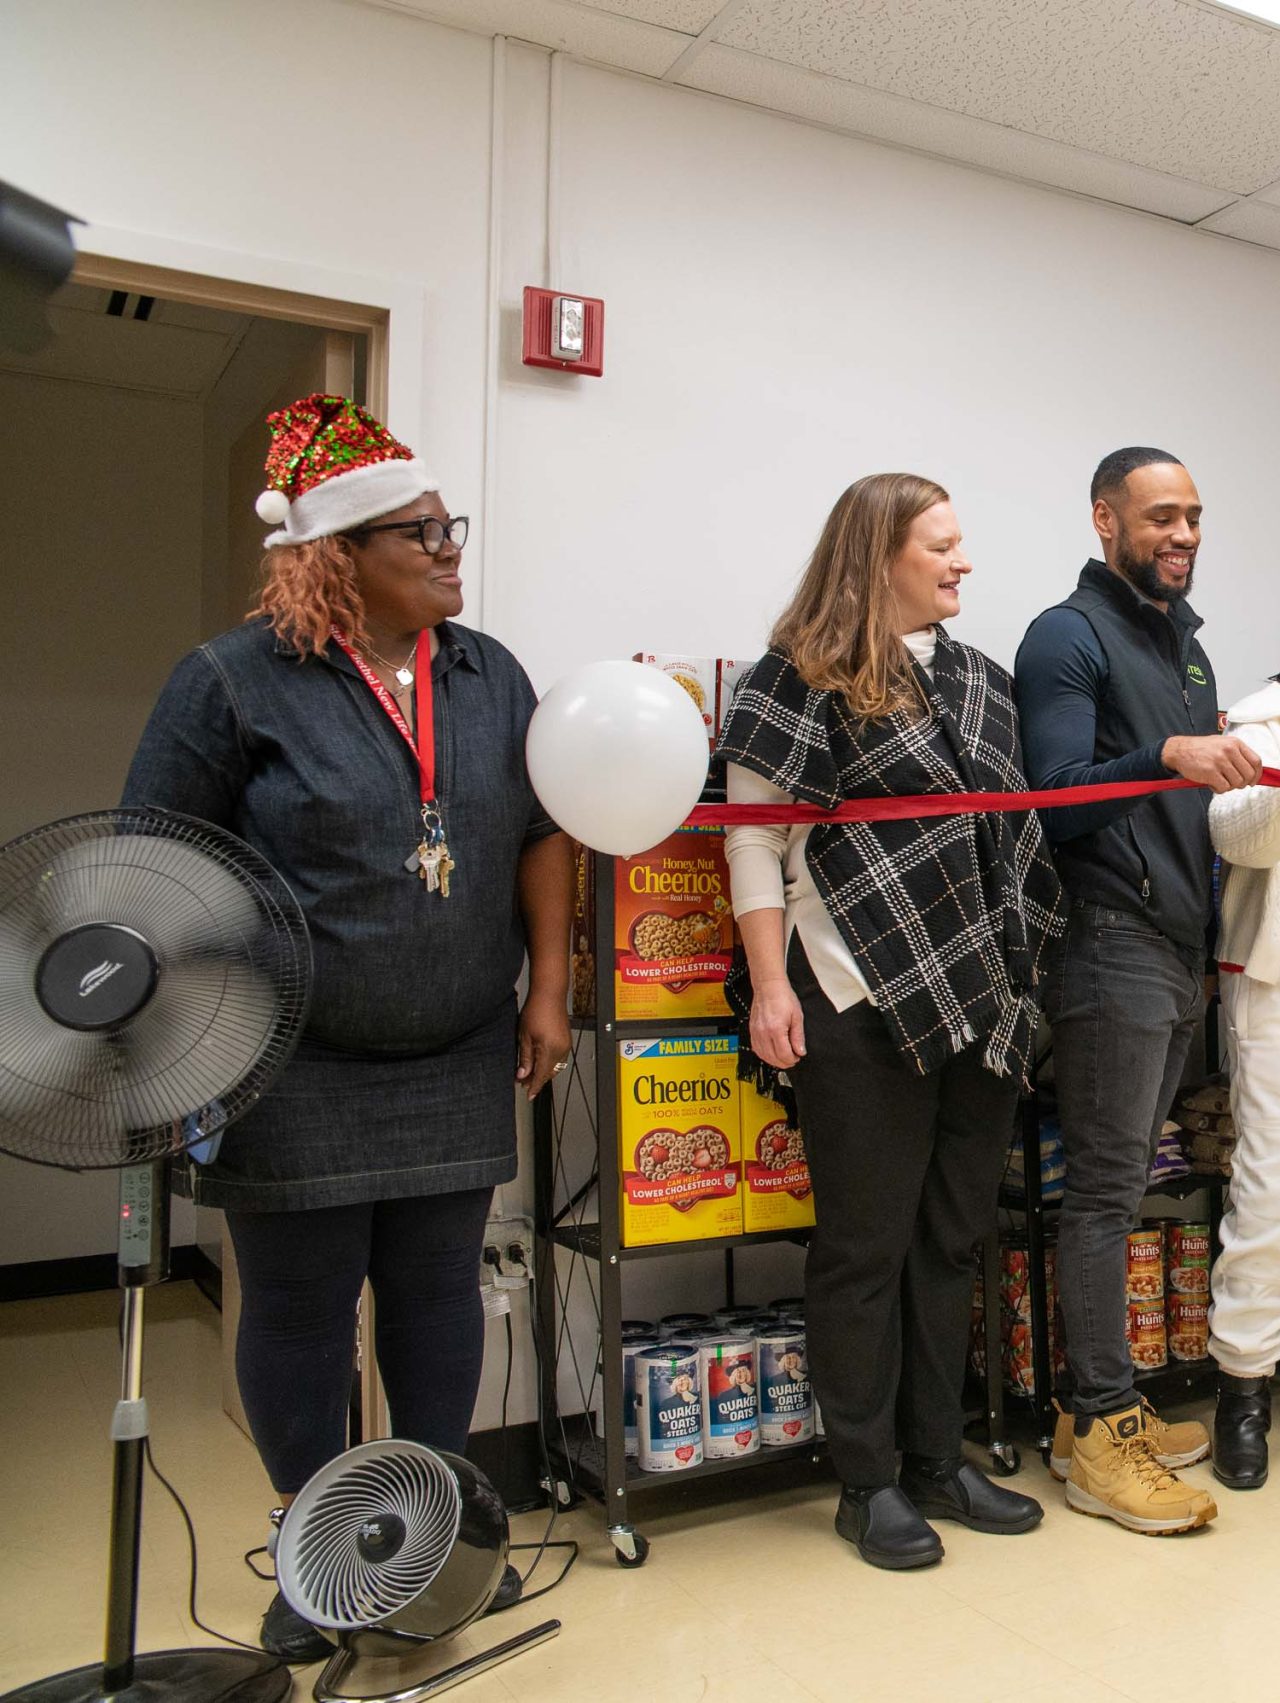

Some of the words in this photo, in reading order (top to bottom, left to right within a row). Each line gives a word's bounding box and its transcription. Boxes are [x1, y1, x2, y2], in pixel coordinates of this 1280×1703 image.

[351, 653, 380, 685] Bethel
[376, 686, 394, 711] New
[391, 710, 408, 735] Life
[663, 858, 694, 872] Honey
[698, 859, 715, 869] Nut
[629, 865, 721, 894] Cheerios
[684, 895, 702, 903] Honey
[626, 968, 660, 977] LOWER
[662, 962, 726, 976] CHOLESTEROL
[660, 959, 676, 968] CAN
[677, 957, 694, 965] HELP
[659, 1040, 702, 1054] FAMILY
[704, 1039, 729, 1052] SIZE
[633, 1073, 731, 1105] Cheerios
[653, 1110, 680, 1118] 100%
[699, 1106, 723, 1115] OATS
[667, 1179, 682, 1187] CAN
[683, 1175, 701, 1184] HELP
[754, 1178, 782, 1186] LOWER
[632, 1189, 664, 1198] LOWER
[665, 1179, 722, 1195] CHOLESTEROL
[1131, 1246, 1159, 1257] Hunt's
[1182, 1239, 1208, 1250] Hunt's
[1137, 1314, 1164, 1326] Hunt's
[767, 1382, 810, 1398] QUAKER
[778, 1393, 804, 1405] OATS
[658, 1404, 700, 1423] QUAKER
[729, 1408, 753, 1422] OATS
[670, 1416, 696, 1430] OATS
[667, 1429, 687, 1438] STEEL
[688, 1426, 698, 1434] CUT
